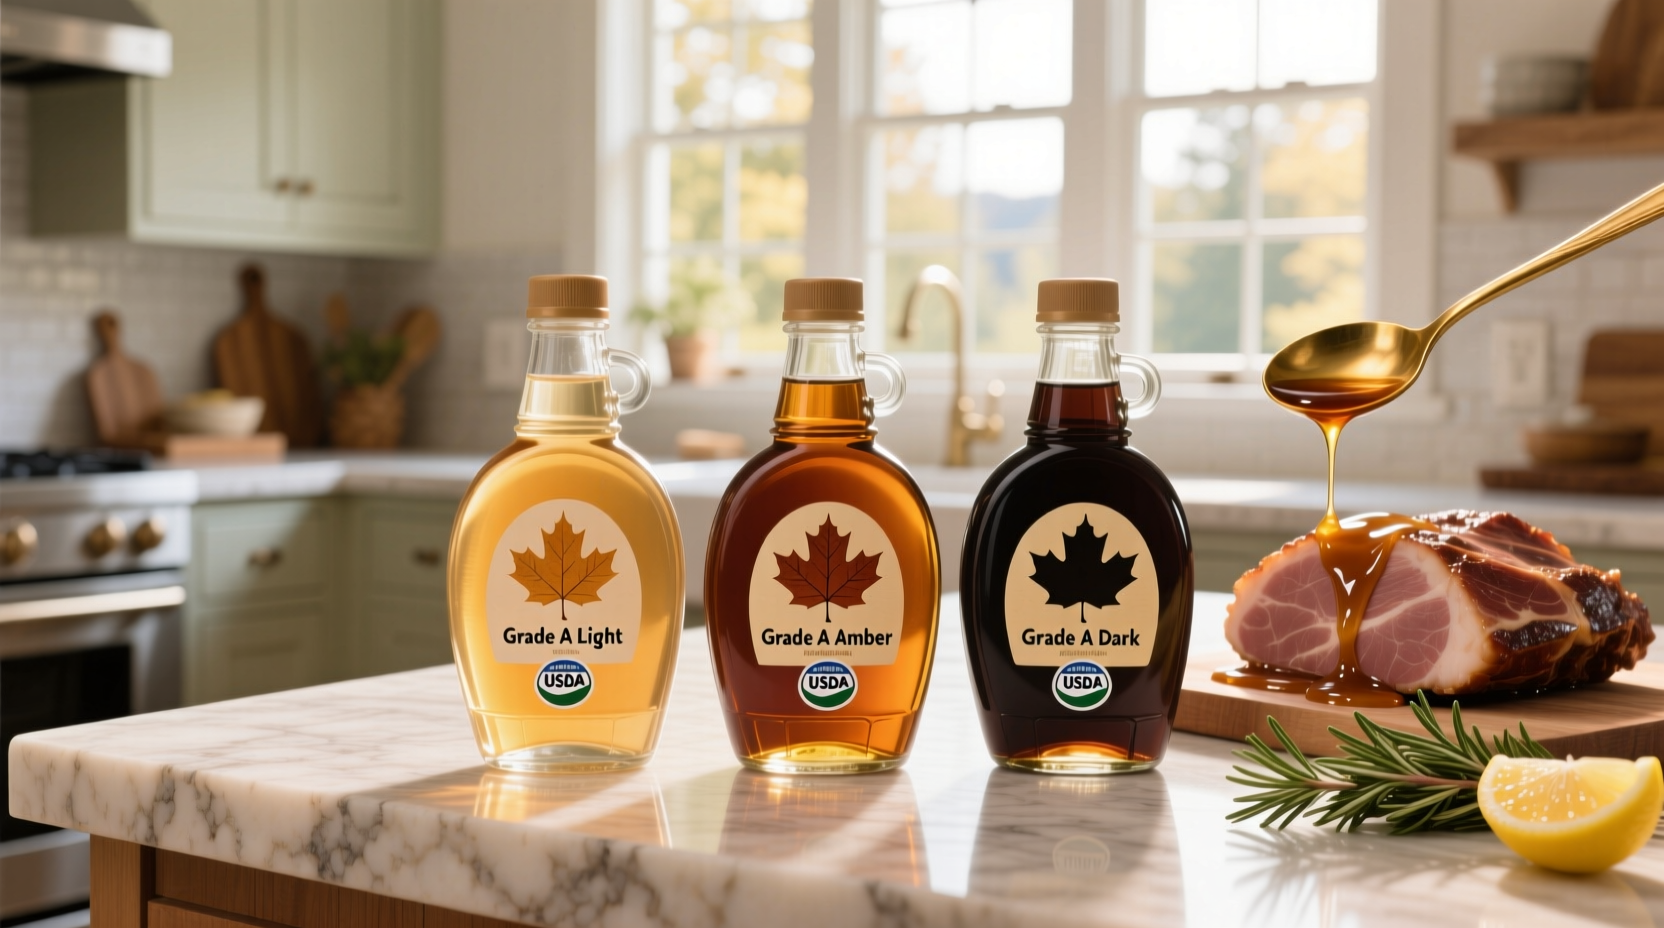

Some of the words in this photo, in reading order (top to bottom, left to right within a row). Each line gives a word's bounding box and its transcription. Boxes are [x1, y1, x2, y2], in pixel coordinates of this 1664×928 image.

[503, 626, 555, 645] Grade
[559, 627, 573, 645] A
[577, 626, 623, 650] Light
[761, 627, 814, 646] Grade
[816, 628, 830, 646] A
[834, 627, 893, 646] Amber
[1021, 627, 1076, 646] Grade
[1080, 628, 1094, 646] A
[1098, 627, 1140, 647] Dark
[544, 673, 585, 688] USDA
[808, 675, 849, 690] USDA
[1063, 675, 1103, 690] USDA
